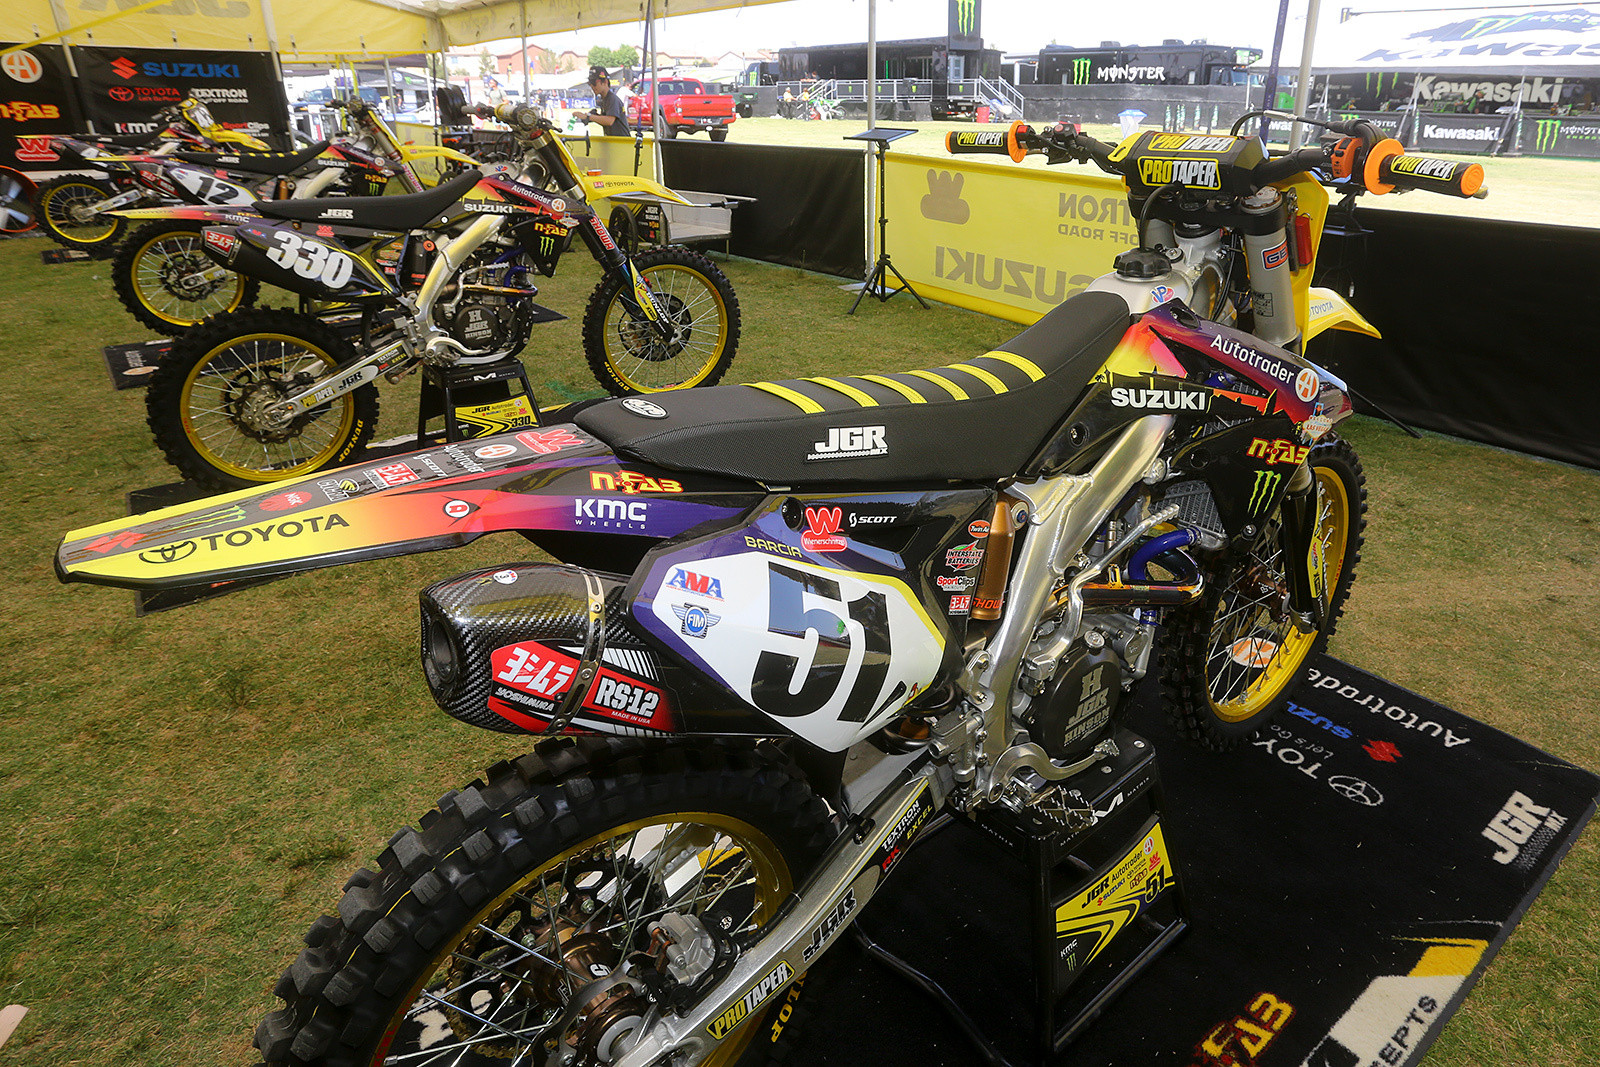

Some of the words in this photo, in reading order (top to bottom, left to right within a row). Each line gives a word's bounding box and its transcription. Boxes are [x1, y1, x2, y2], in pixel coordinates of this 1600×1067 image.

[143, 62, 242, 78] SUZUKI
[1097, 64, 1166, 82] MONSTER
[134, 87, 181, 97] TOYOTA
[1412, 75, 1564, 104] Kawasaki
[957, 131, 1003, 147] PROTAPER
[1152, 134, 1233, 152] PROTAPER
[1423, 124, 1500, 142] Kawasaki
[317, 159, 350, 168] SUZUKI
[1142, 159, 1218, 188] PROTAPER
[1392, 156, 1457, 180] PROTAPER
[196, 176, 239, 201] 12
[511, 184, 552, 206] Autotrader
[318, 208, 354, 219] JGR
[463, 202, 513, 214] SUZUKI
[534, 222, 569, 237] n-FAB
[589, 216, 615, 250] SHOWA
[266, 230, 354, 289] 330
[1266, 245, 1288, 264] GE
[1310, 301, 1334, 316] TOYOTA
[1210, 333, 1295, 385] Autotrader
[338, 371, 363, 391] JGR
[603, 361, 631, 392] DUNLOP
[471, 405, 491, 414] JGR
[1111, 387, 1206, 411] SUZUKI
[511, 415, 531, 427] 330
[338, 418, 364, 463] DUNLOP
[814, 425, 888, 453] JGR
[1246, 437, 1310, 465] n-FAB
[589, 470, 684, 494] n-FAB
[284, 491, 304, 506] NGK
[575, 519, 646, 530] WHEELS
[857, 515, 898, 524] SCOTT
[201, 513, 350, 552] TOYOTA
[744, 535, 803, 558] BARCIA
[947, 549, 983, 558] INTERSTATE
[946, 557, 981, 565] BATTERIES
[665, 567, 725, 600] AMA
[937, 576, 976, 587] SportClips
[973, 597, 1003, 609] HOW
[687, 613, 705, 628] FIM
[750, 560, 892, 724] 51
[496, 686, 556, 712] YOSHIMURA
[1067, 688, 1110, 729] JGR
[1307, 667, 1471, 749] Autotrade
[611, 711, 630, 720] MADE
[637, 715, 651, 724] USA
[1064, 706, 1111, 744] HINSON
[1286, 701, 1353, 739] SUZ
[1252, 735, 1322, 779] TOY
[1126, 777, 1150, 797] MATRIX
[881, 799, 920, 850] TEXTRON
[906, 804, 933, 840] EXCEL
[1481, 790, 1551, 865] JGR
[1060, 831, 1079, 847] MATR
[1082, 876, 1110, 909] JGR
[1111, 850, 1143, 883] Autotrader
[1103, 878, 1126, 900] SUZUKI
[1145, 864, 1165, 904] 51
[803, 888, 857, 956] JGR
[713, 965, 792, 1037] PROTAPER
[771, 971, 808, 1043] NLOP
[1370, 996, 1438, 1067] EPTS
